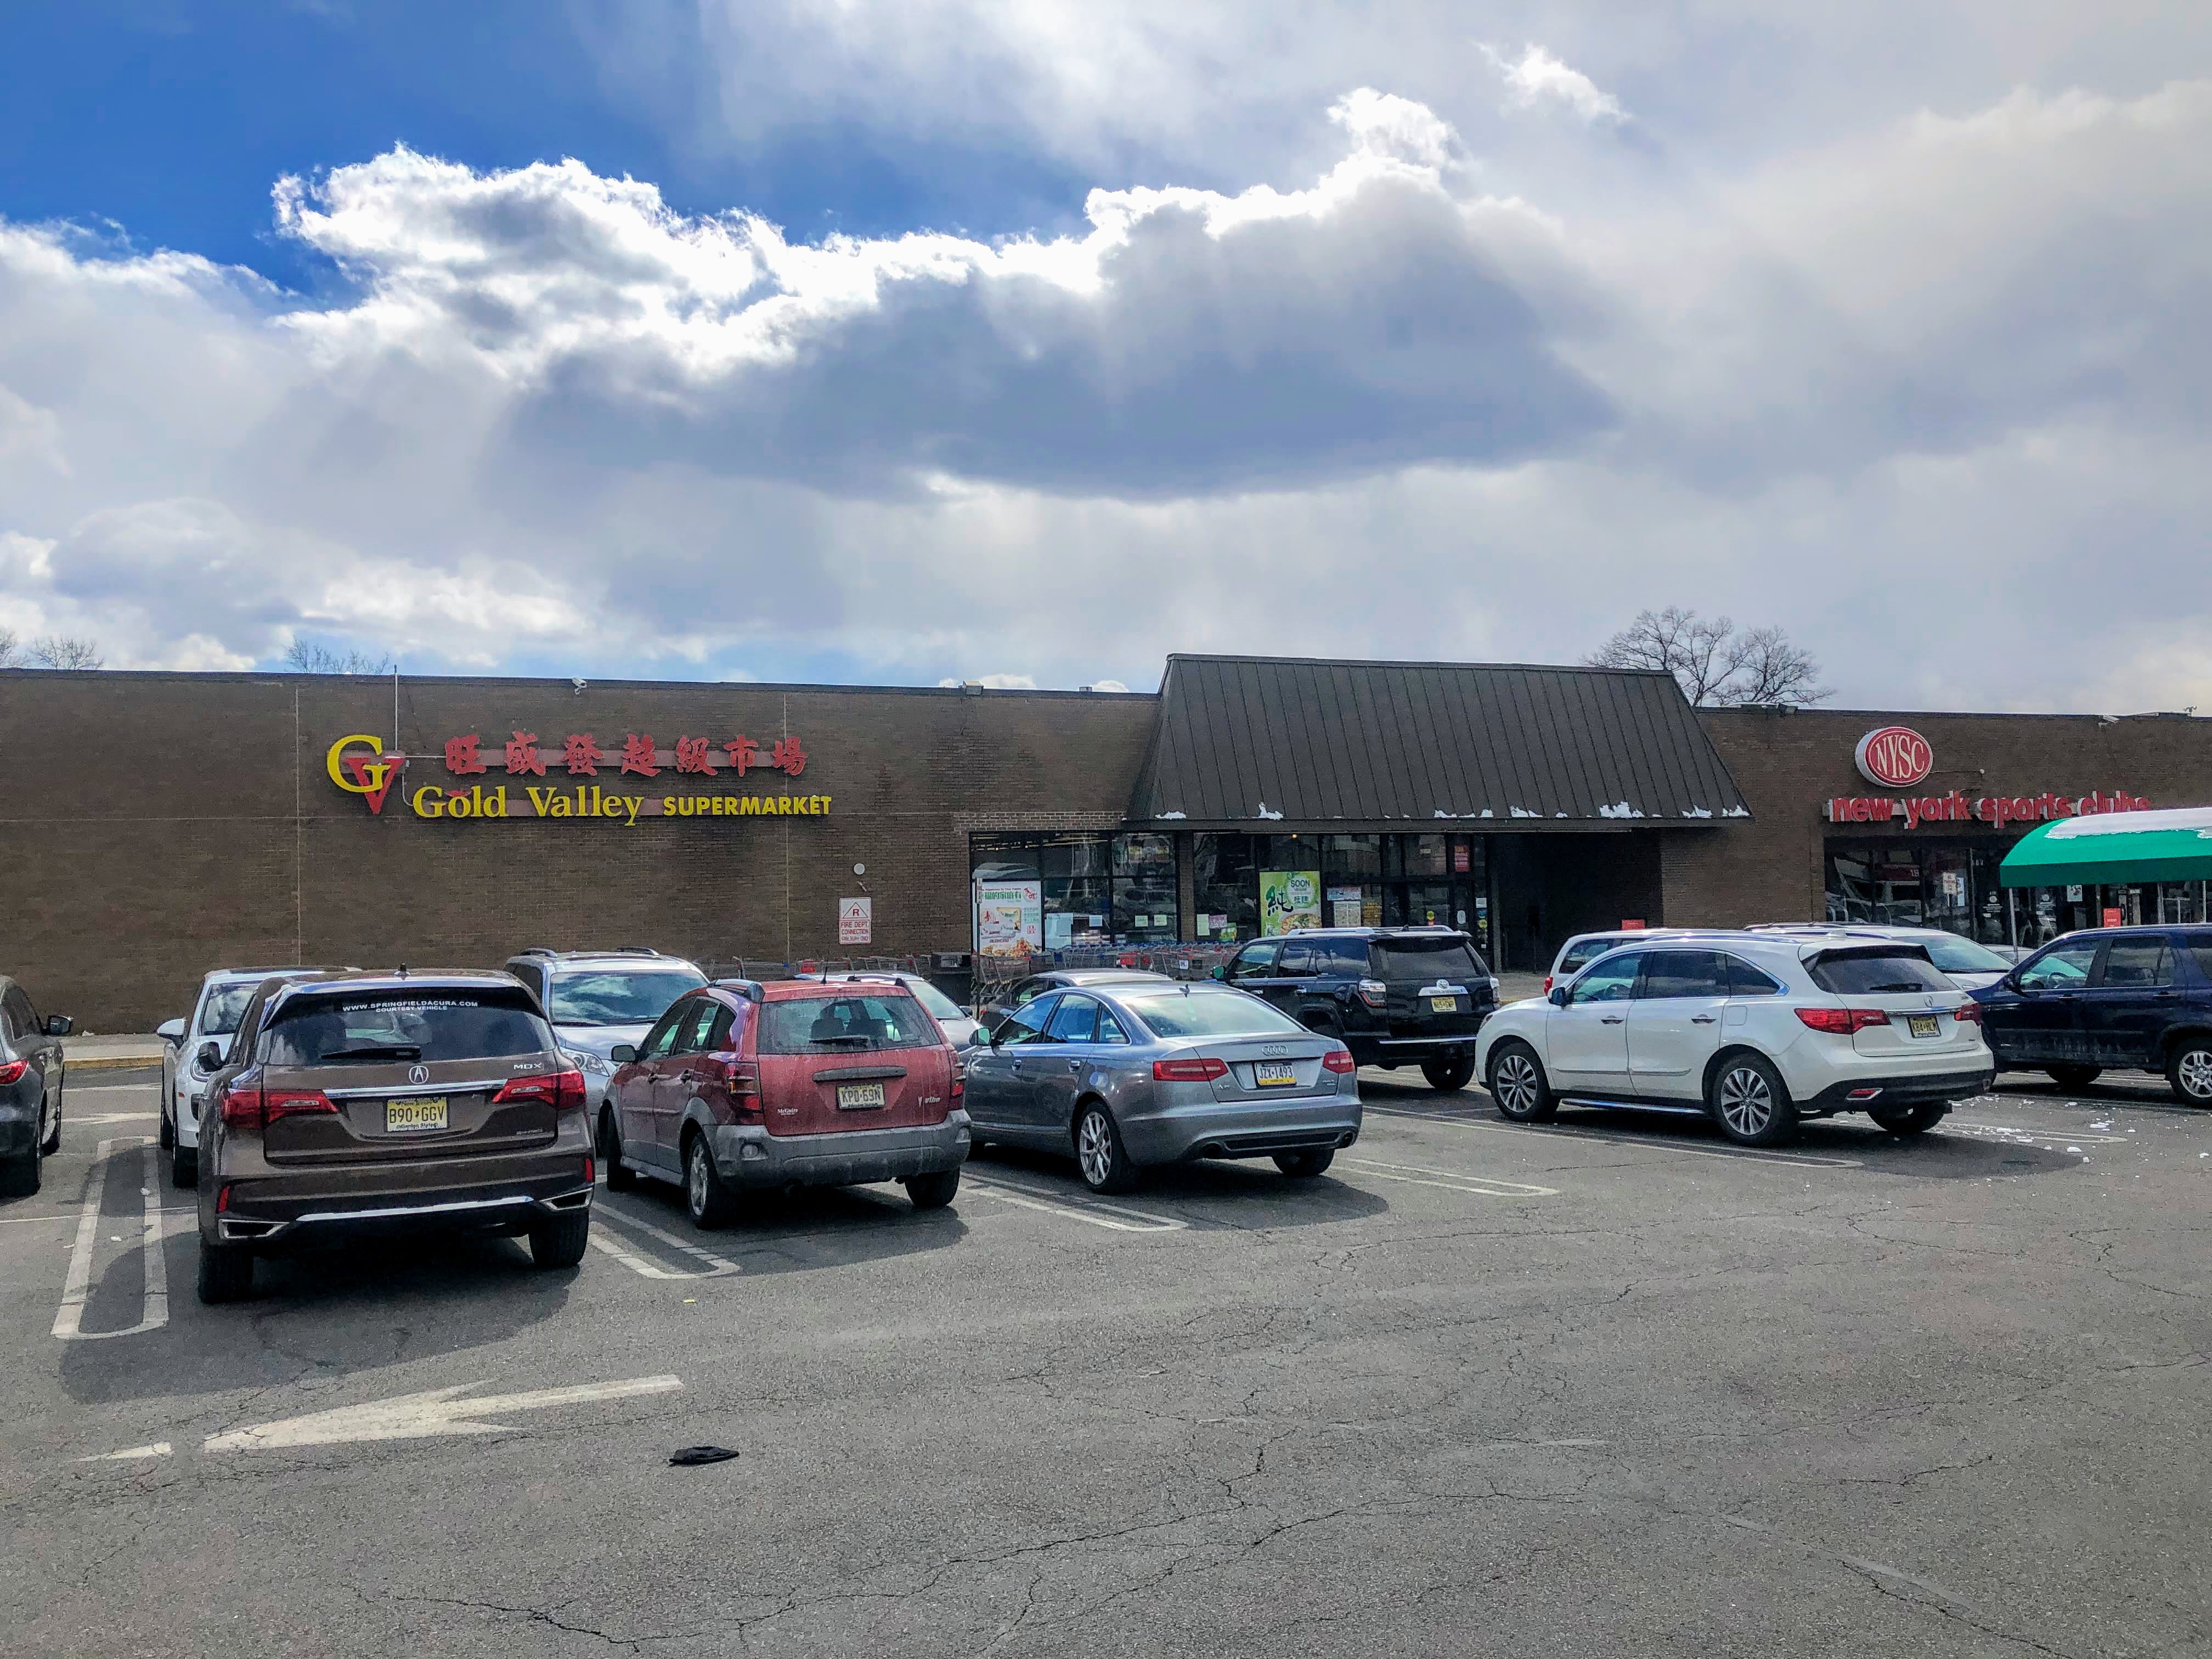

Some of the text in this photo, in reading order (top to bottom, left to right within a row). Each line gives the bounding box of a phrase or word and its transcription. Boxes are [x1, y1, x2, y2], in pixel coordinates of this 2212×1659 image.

[1875, 735, 1925, 778] NYSC
[413, 785, 832, 826] Gold Valley SUPERMARKET
[1830, 798, 1893, 822] new
[1902, 791, 1973, 830] york
[1977, 792, 2072, 828] sports
[342, 1001, 478, 1012] WWW.SPRINGFIELDACURA.COM
